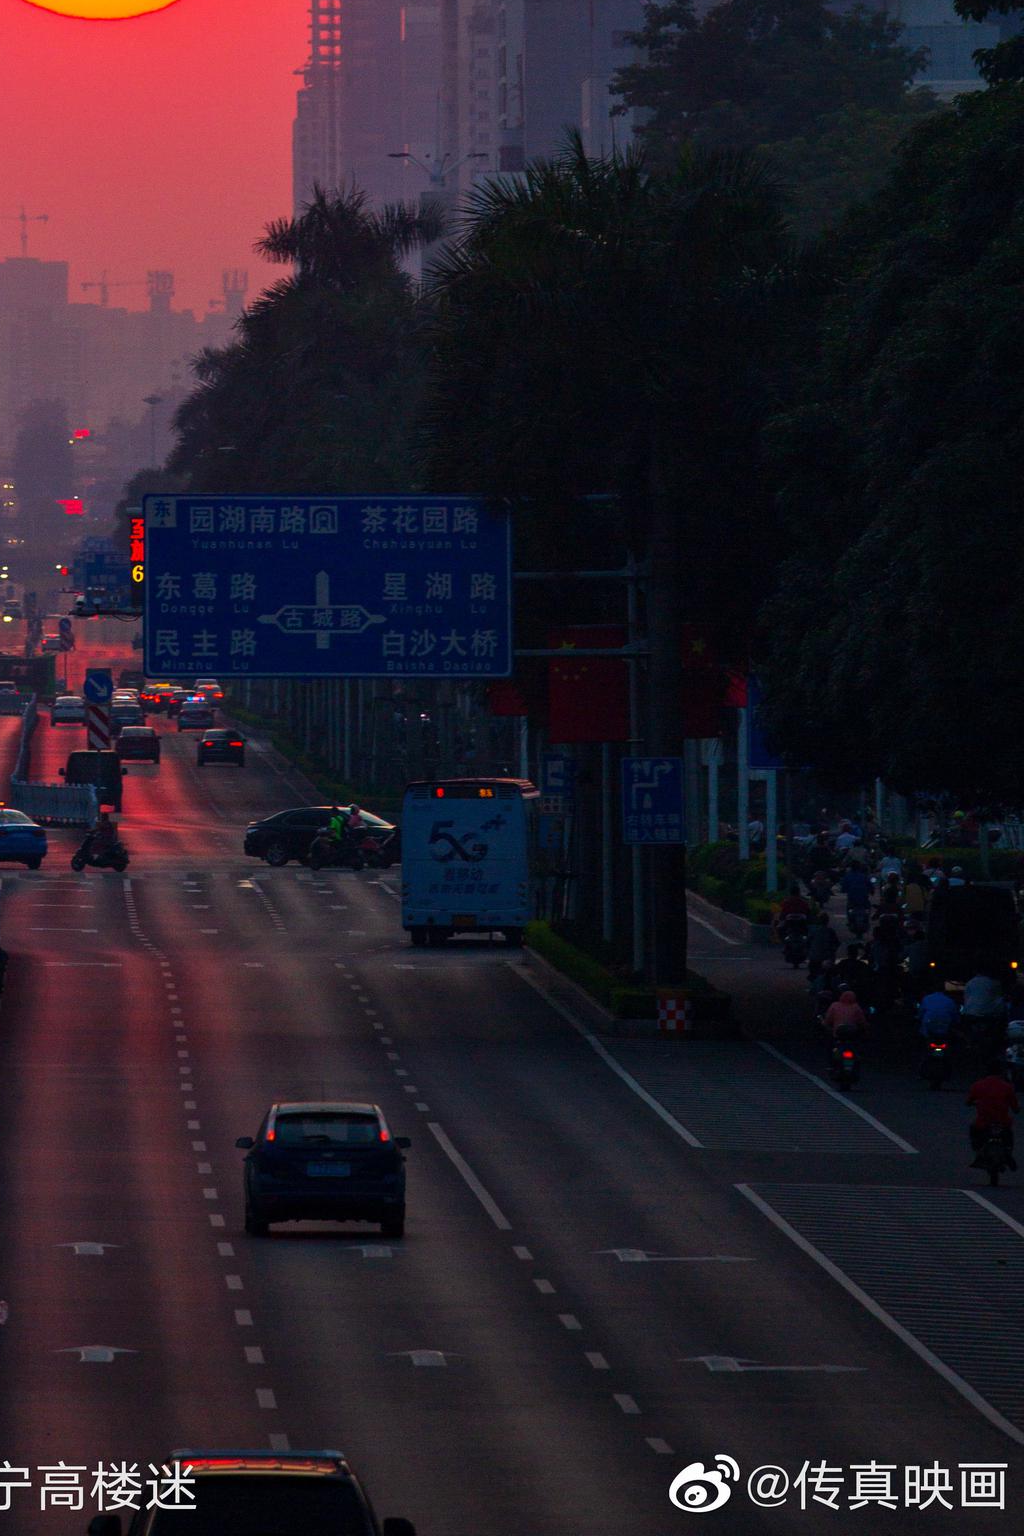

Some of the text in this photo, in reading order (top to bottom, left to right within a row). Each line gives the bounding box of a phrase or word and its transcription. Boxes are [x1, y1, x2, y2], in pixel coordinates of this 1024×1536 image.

[154, 500, 170, 518] 东
[189, 505, 306, 534] 园湖南路
[361, 505, 479, 534] 茶花园路
[282, 539, 299, 550] Lu
[461, 539, 477, 550] Lu
[155, 572, 258, 600] 东葛路
[382, 571, 497, 600] 星湖路
[233, 603, 249, 614] Lu
[285, 608, 361, 628] 古城路
[155, 628, 258, 657] 民主路
[382, 628, 498, 657] 白沙大桥
[232, 660, 249, 670] Lu
